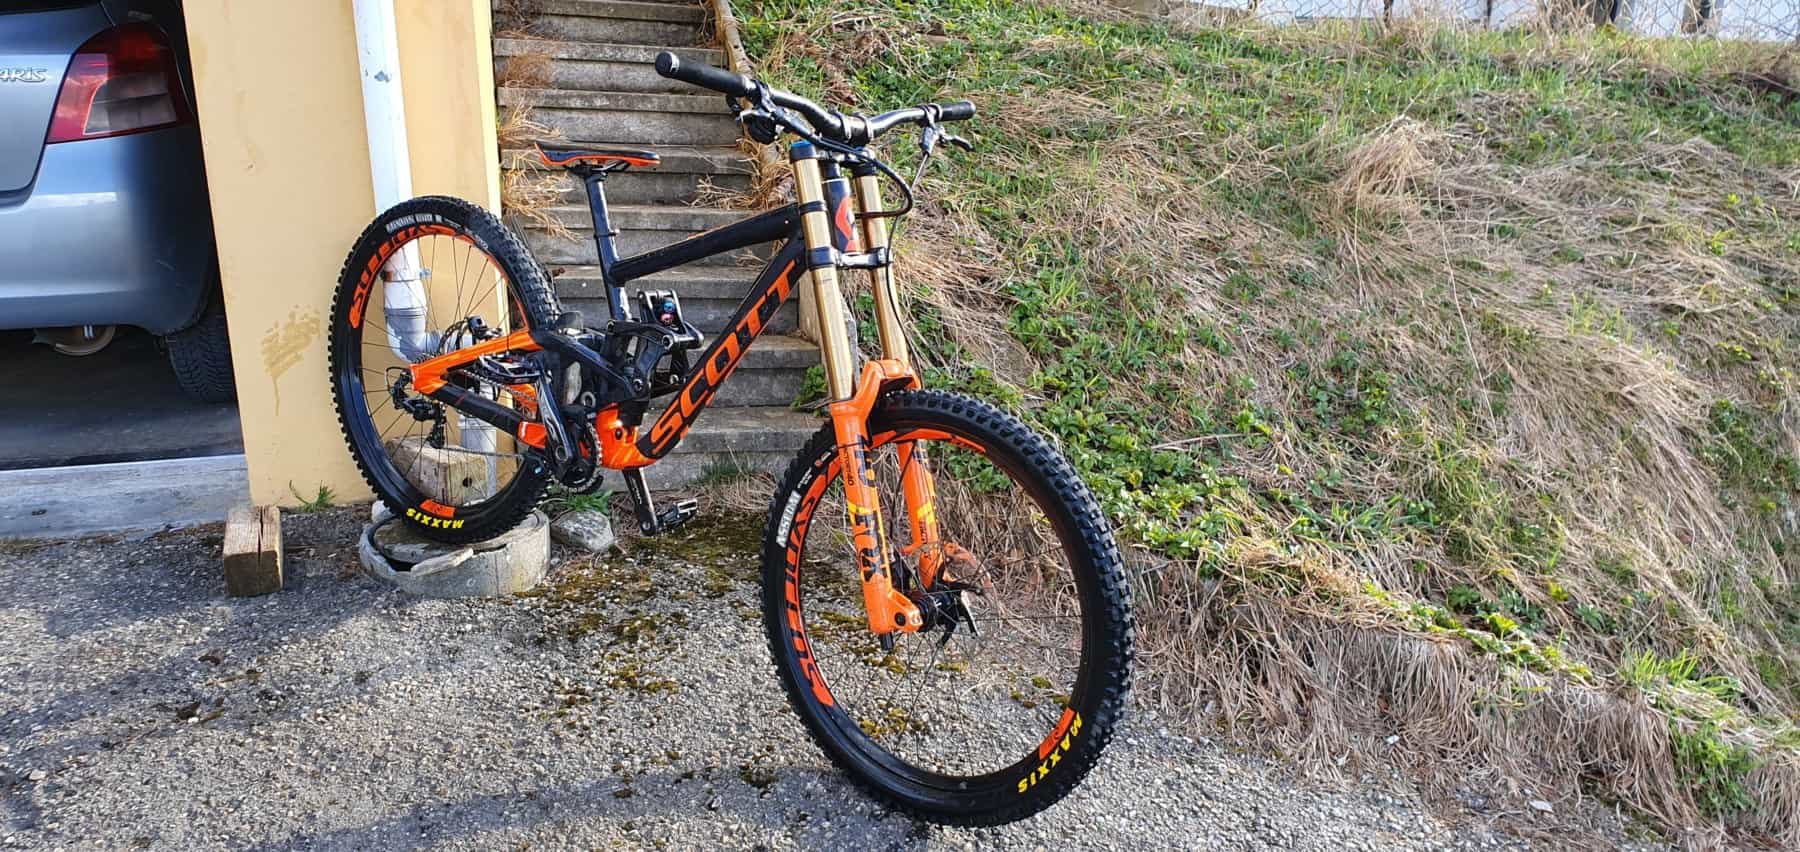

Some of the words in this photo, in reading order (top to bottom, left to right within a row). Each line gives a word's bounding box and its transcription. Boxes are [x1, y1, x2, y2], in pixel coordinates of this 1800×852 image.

[651, 260, 796, 455] SCOTT
[406, 508, 464, 529] MAXXIS
[1018, 712, 1082, 793] MAXXIS
